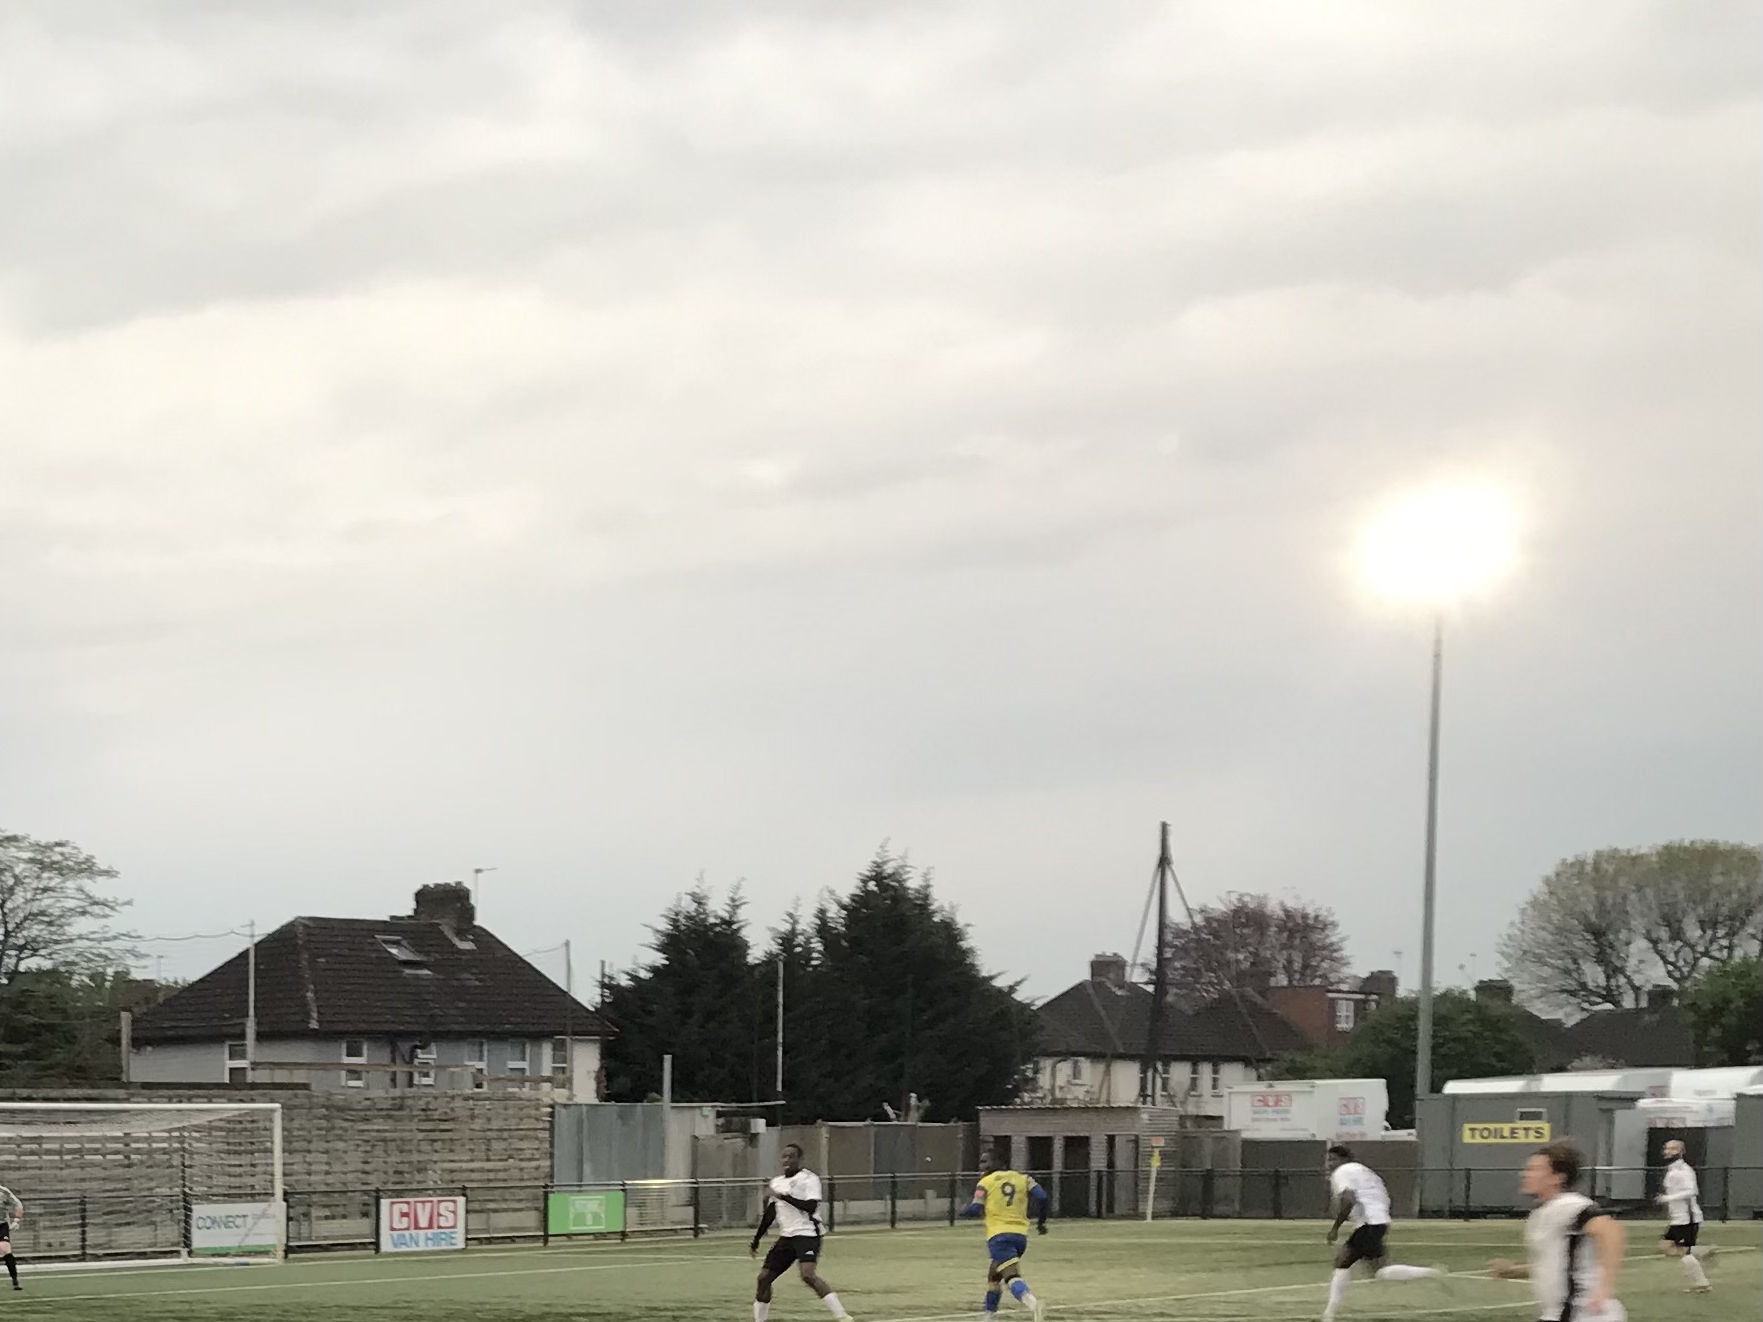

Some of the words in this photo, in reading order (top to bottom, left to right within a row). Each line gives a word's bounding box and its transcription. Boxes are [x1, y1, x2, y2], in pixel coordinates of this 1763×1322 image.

[1468, 1127, 1545, 1139] TOILETS
[1001, 1182, 1015, 1206] 9
[391, 1200, 456, 1230] CVS
[390, 1233, 419, 1248] VAN
[425, 1231, 457, 1247] HIRE
